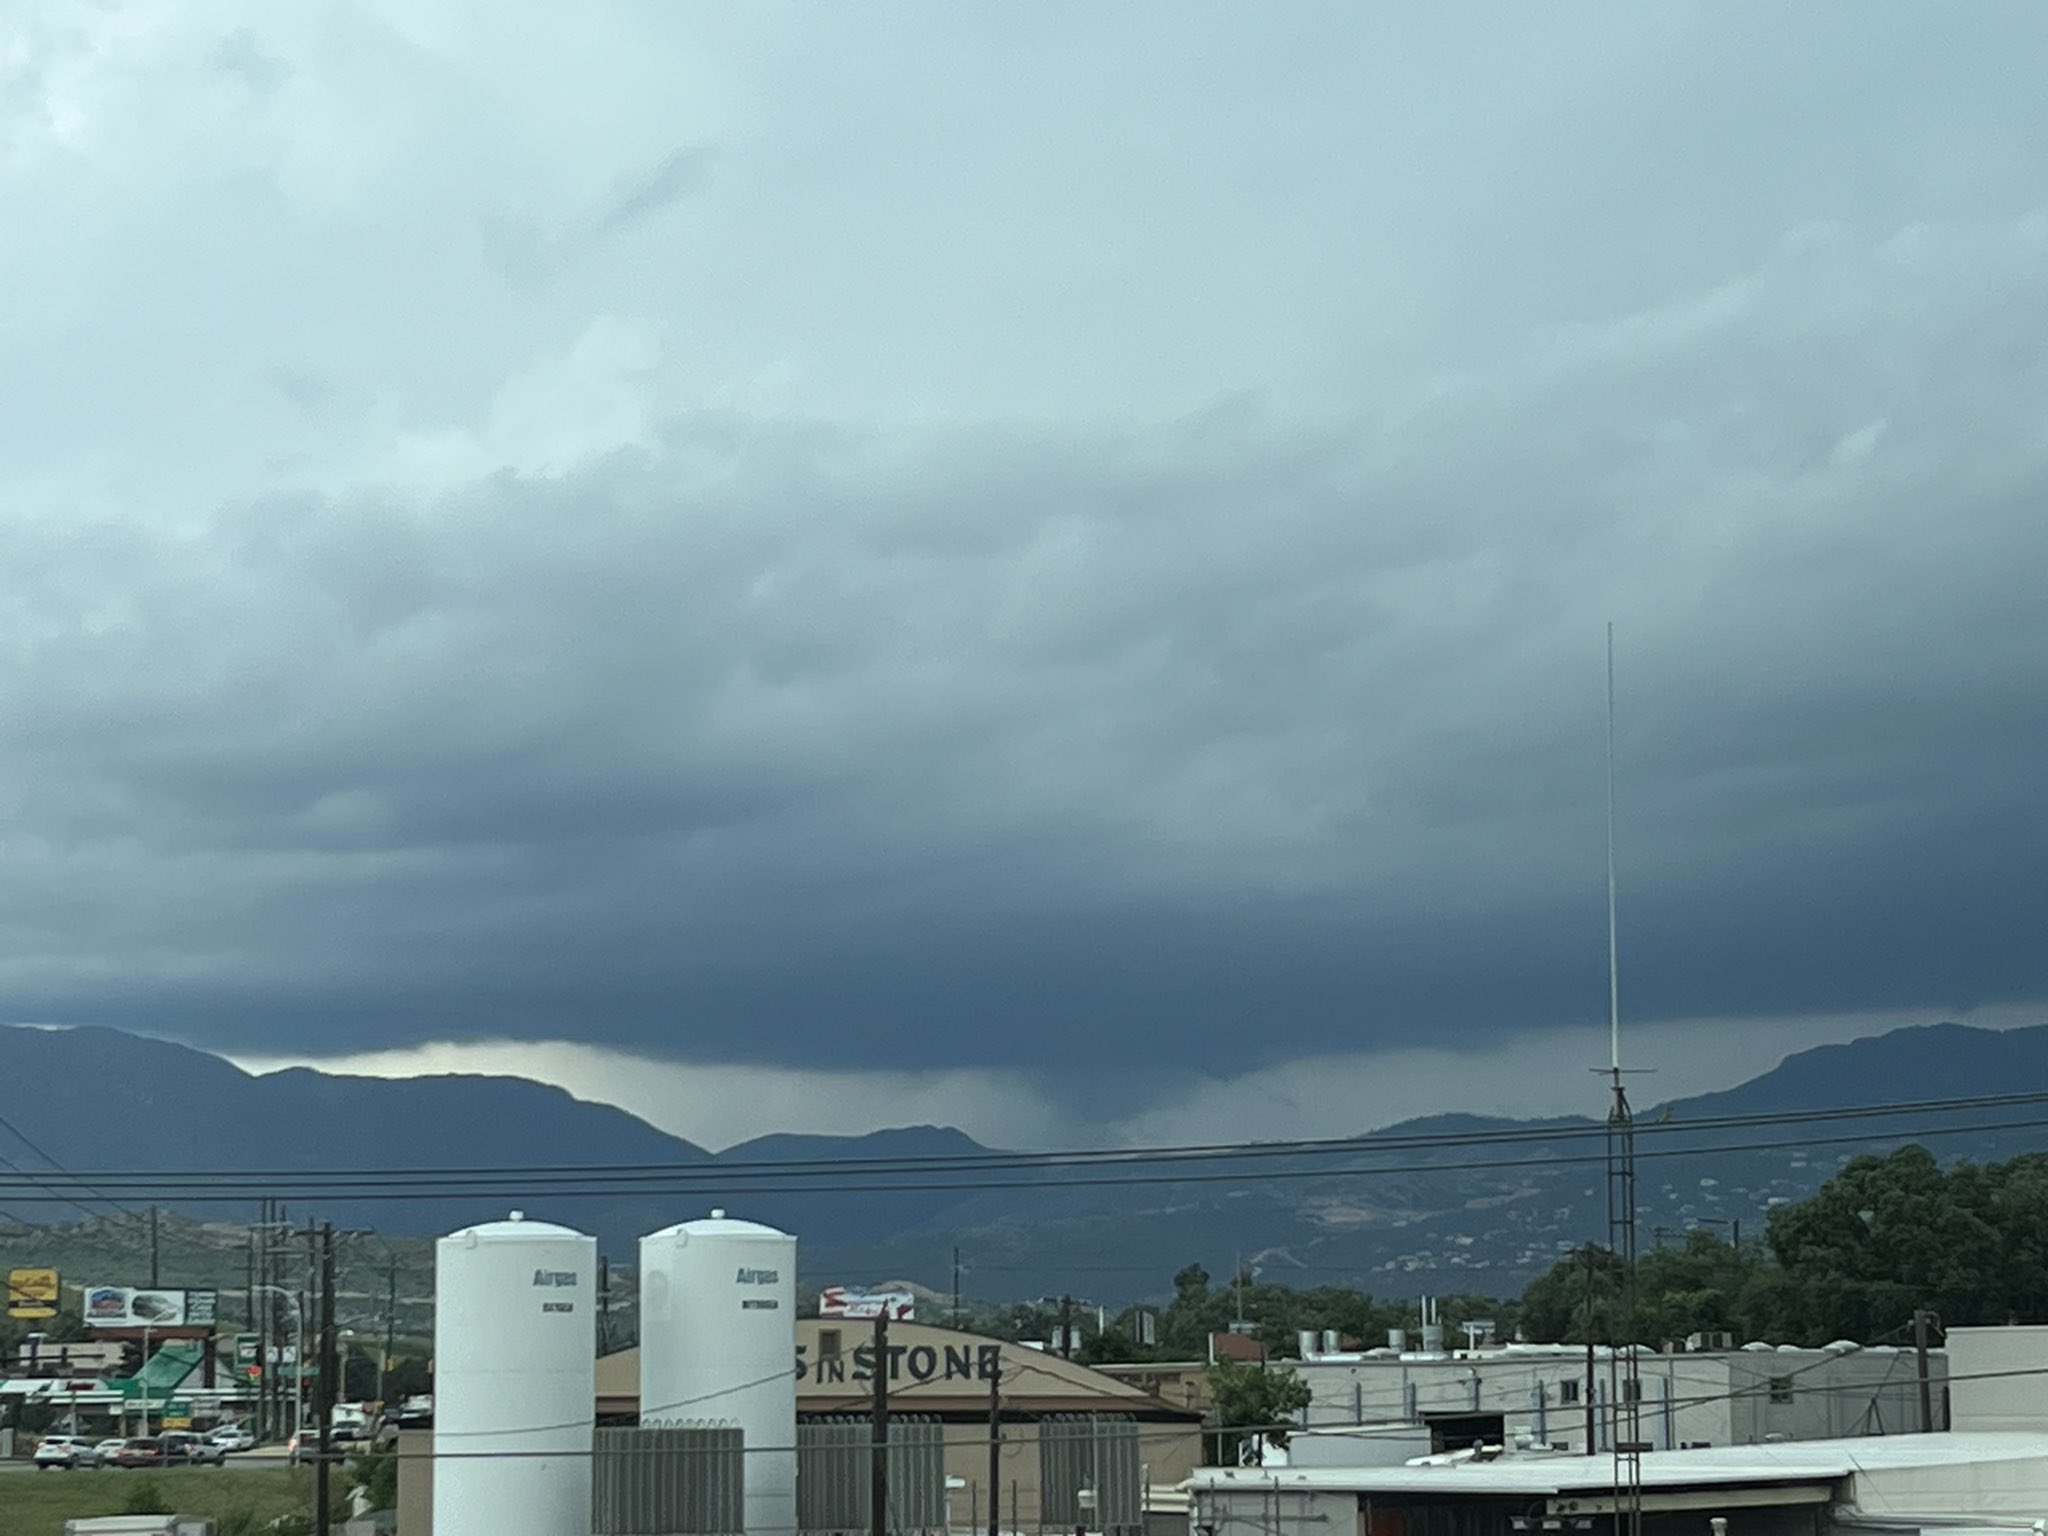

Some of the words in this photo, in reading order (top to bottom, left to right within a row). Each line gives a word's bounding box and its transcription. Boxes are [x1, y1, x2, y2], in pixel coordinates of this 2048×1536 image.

[533, 1269, 577, 1288] Airgas
[736, 1267, 779, 1285] Airgas
[816, 1360, 844, 1384] IN
[852, 1345, 1001, 1380] STONE
